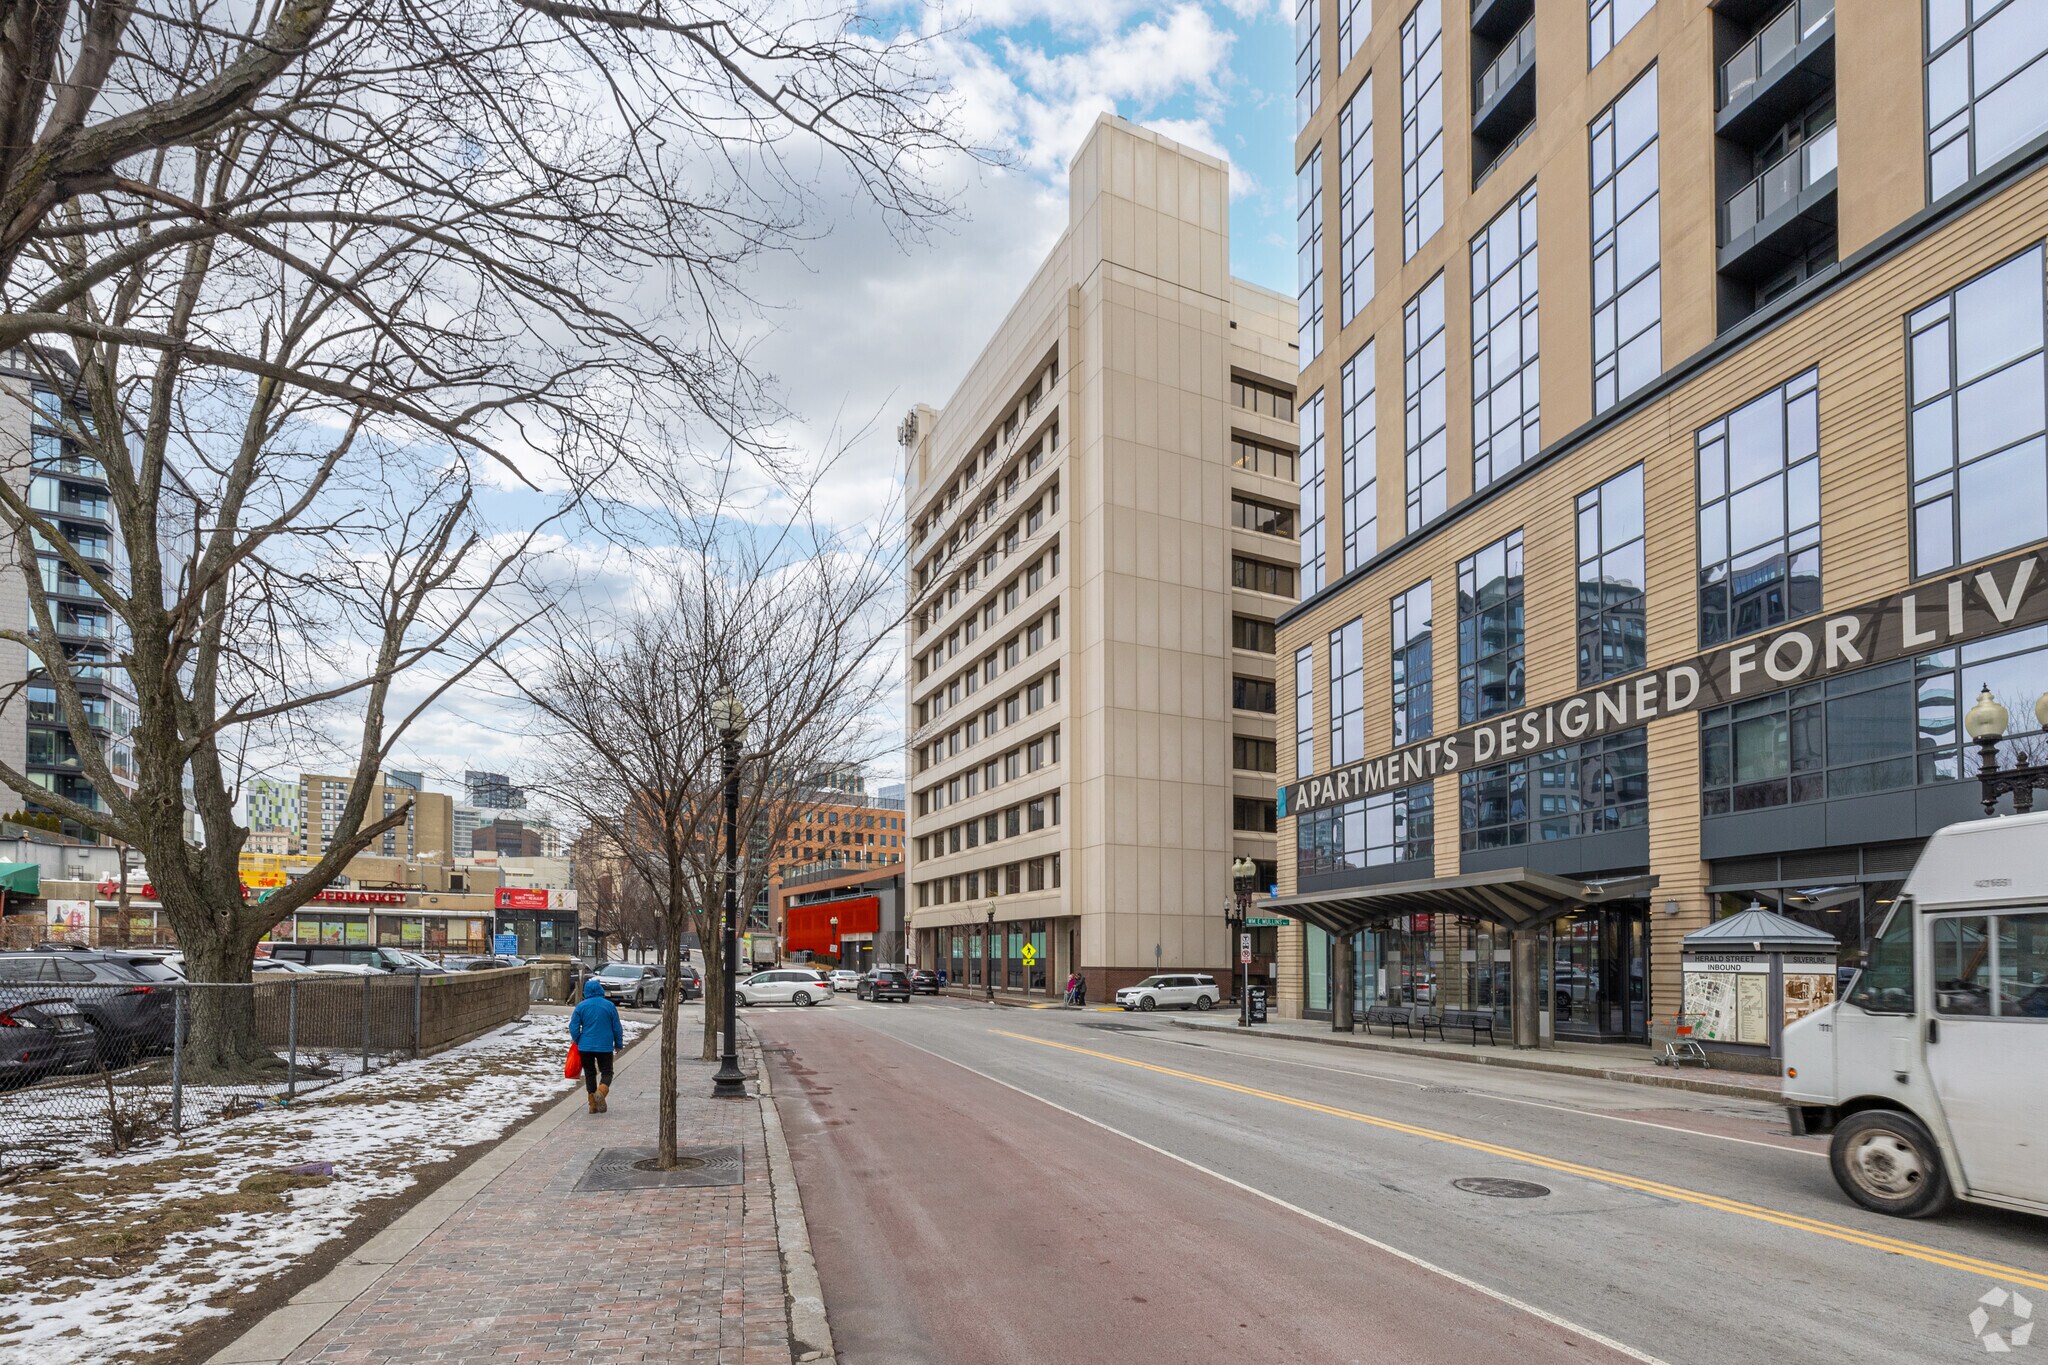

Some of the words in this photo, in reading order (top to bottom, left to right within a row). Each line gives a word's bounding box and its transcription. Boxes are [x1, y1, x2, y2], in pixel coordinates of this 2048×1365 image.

[1295, 736, 1459, 812] APARTMENTS
[1474, 666, 1700, 763] DESIGNED
[1730, 615, 1863, 694] FOR
[1902, 557, 2038, 648] LIV
[312, 891, 406, 905] PERMARKET
[1694, 955, 1724, 963] HERALD
[1725, 955, 1755, 963] STREET
[1792, 956, 1827, 964] SILVERLINE
